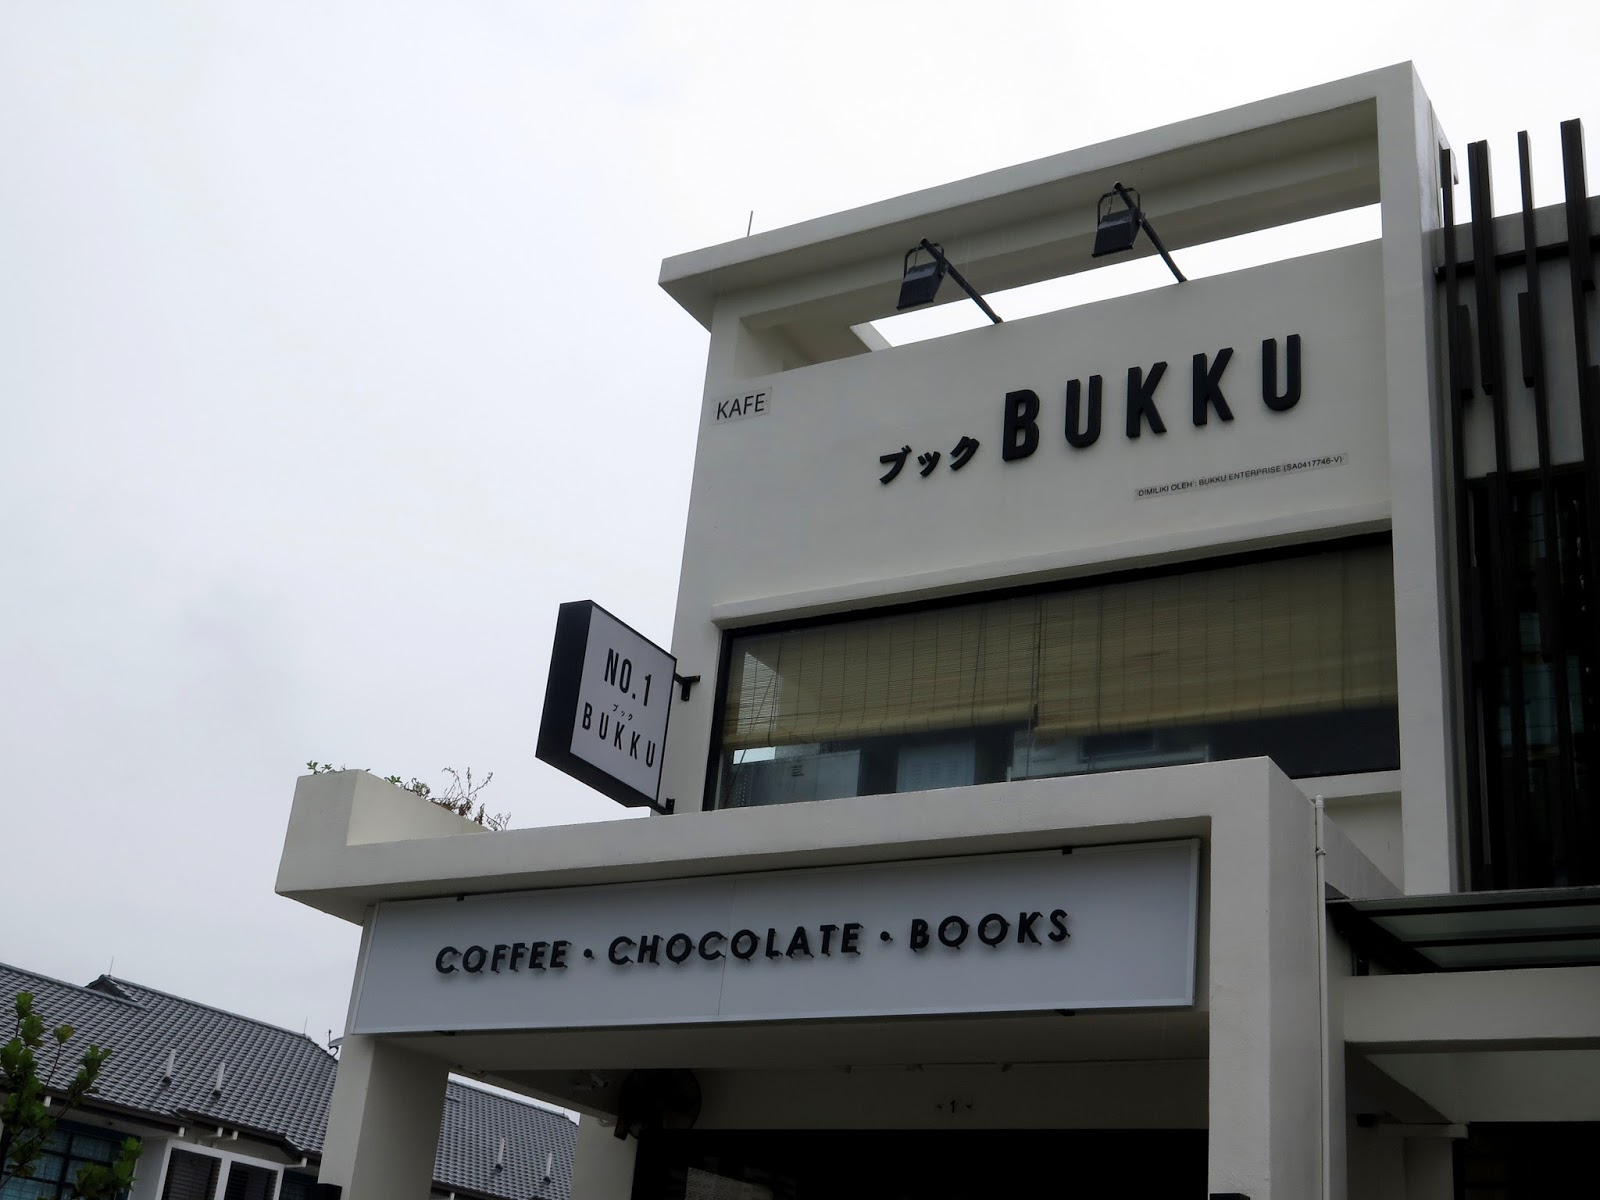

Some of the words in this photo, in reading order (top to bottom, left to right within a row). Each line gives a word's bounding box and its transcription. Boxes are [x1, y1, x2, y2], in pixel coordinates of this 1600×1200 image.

[716, 393, 766, 420] KAFE
[1003, 334, 1301, 462] BUKKU
[879, 436, 980, 485] ブック
[1138, 485, 1169, 497] DIMILIKI
[1171, 481, 1193, 491] OLEH
[1199, 475, 1227, 486] BUKKU
[1229, 466, 1281, 481] ENTERPRISE
[582, 701, 656, 768] BUKKU
[435, 940, 570, 974] COFFEE
[608, 922, 864, 967] CHOCOLATE
[909, 908, 1071, 952] BOOKS
